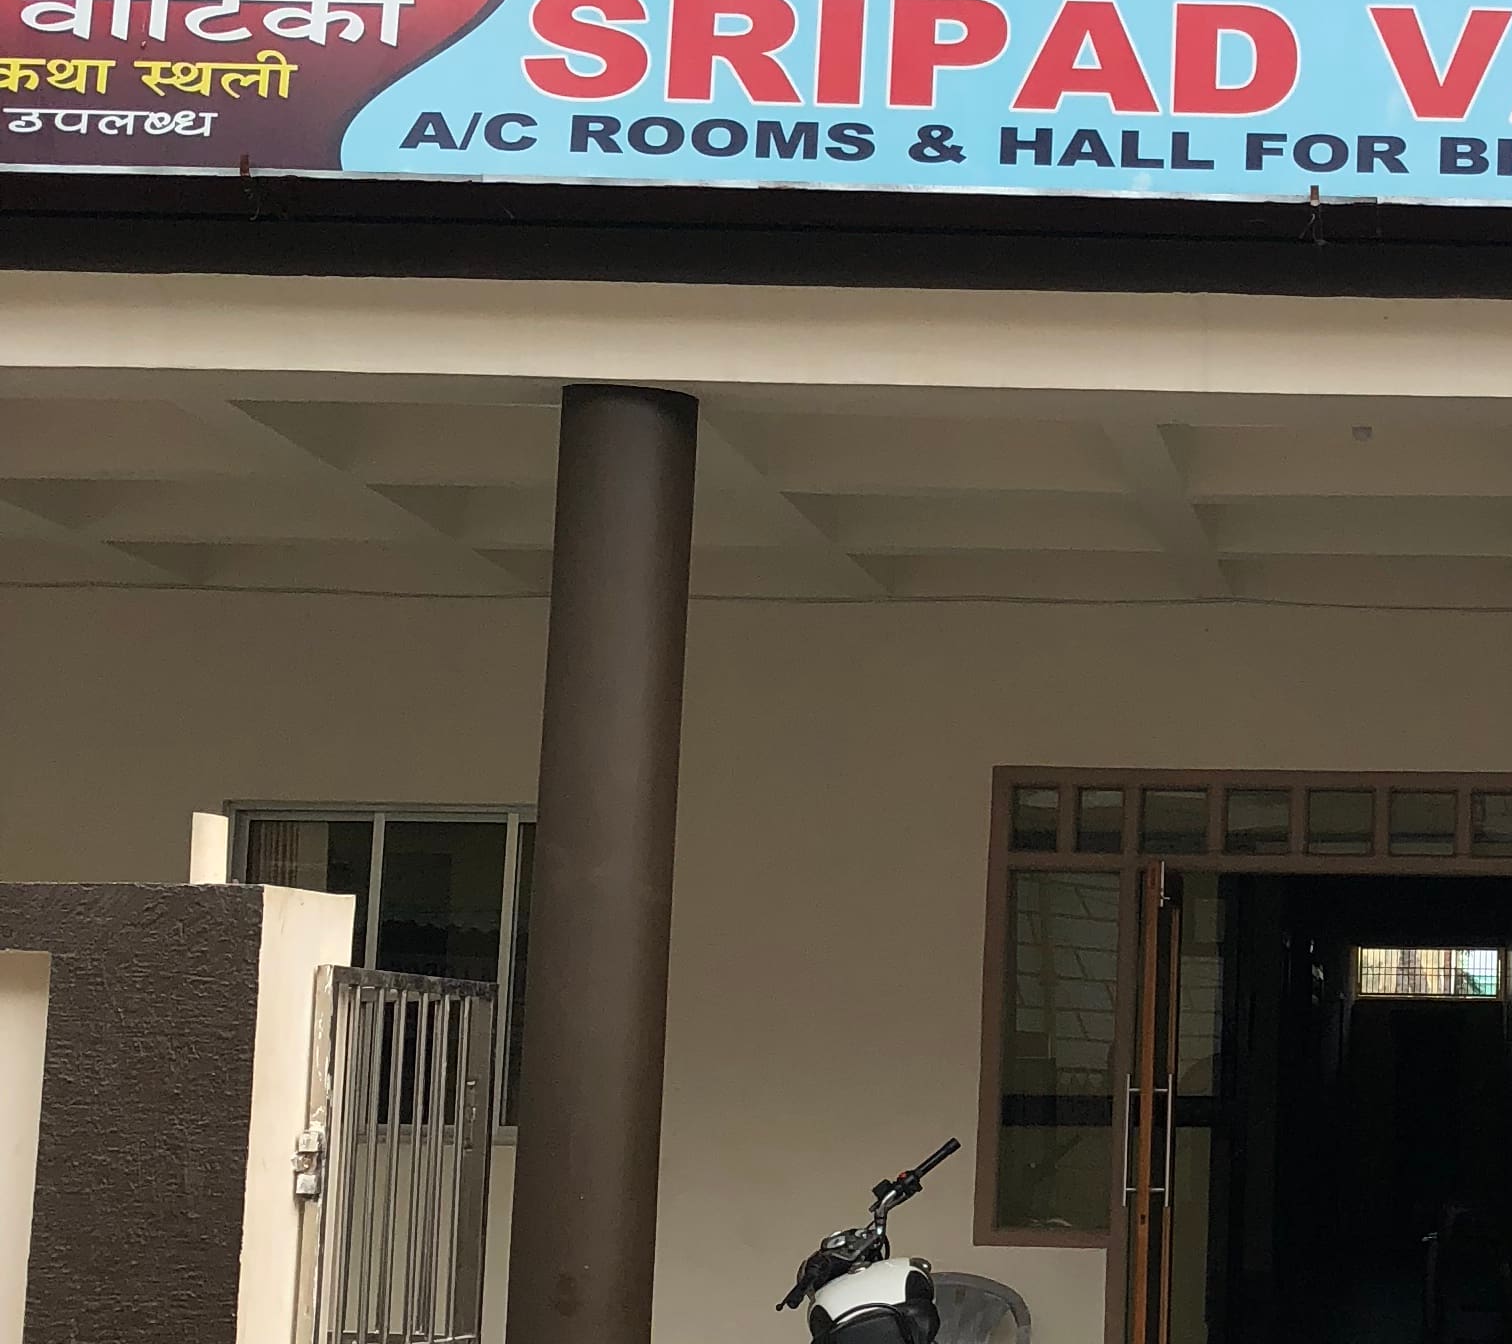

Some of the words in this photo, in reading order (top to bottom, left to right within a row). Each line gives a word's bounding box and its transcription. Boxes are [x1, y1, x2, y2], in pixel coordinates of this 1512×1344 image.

[0, 57, 117, 95] कथा
[133, 49, 299, 99] स्थली
[2, 107, 219, 137] उपलब्ध
[399, 110, 539, 152] A/C
[569, 114, 877, 162] ROOMS
[907, 123, 968, 164] &
[999, 126, 1216, 170] HALL
[1244, 132, 1411, 174] FOR
